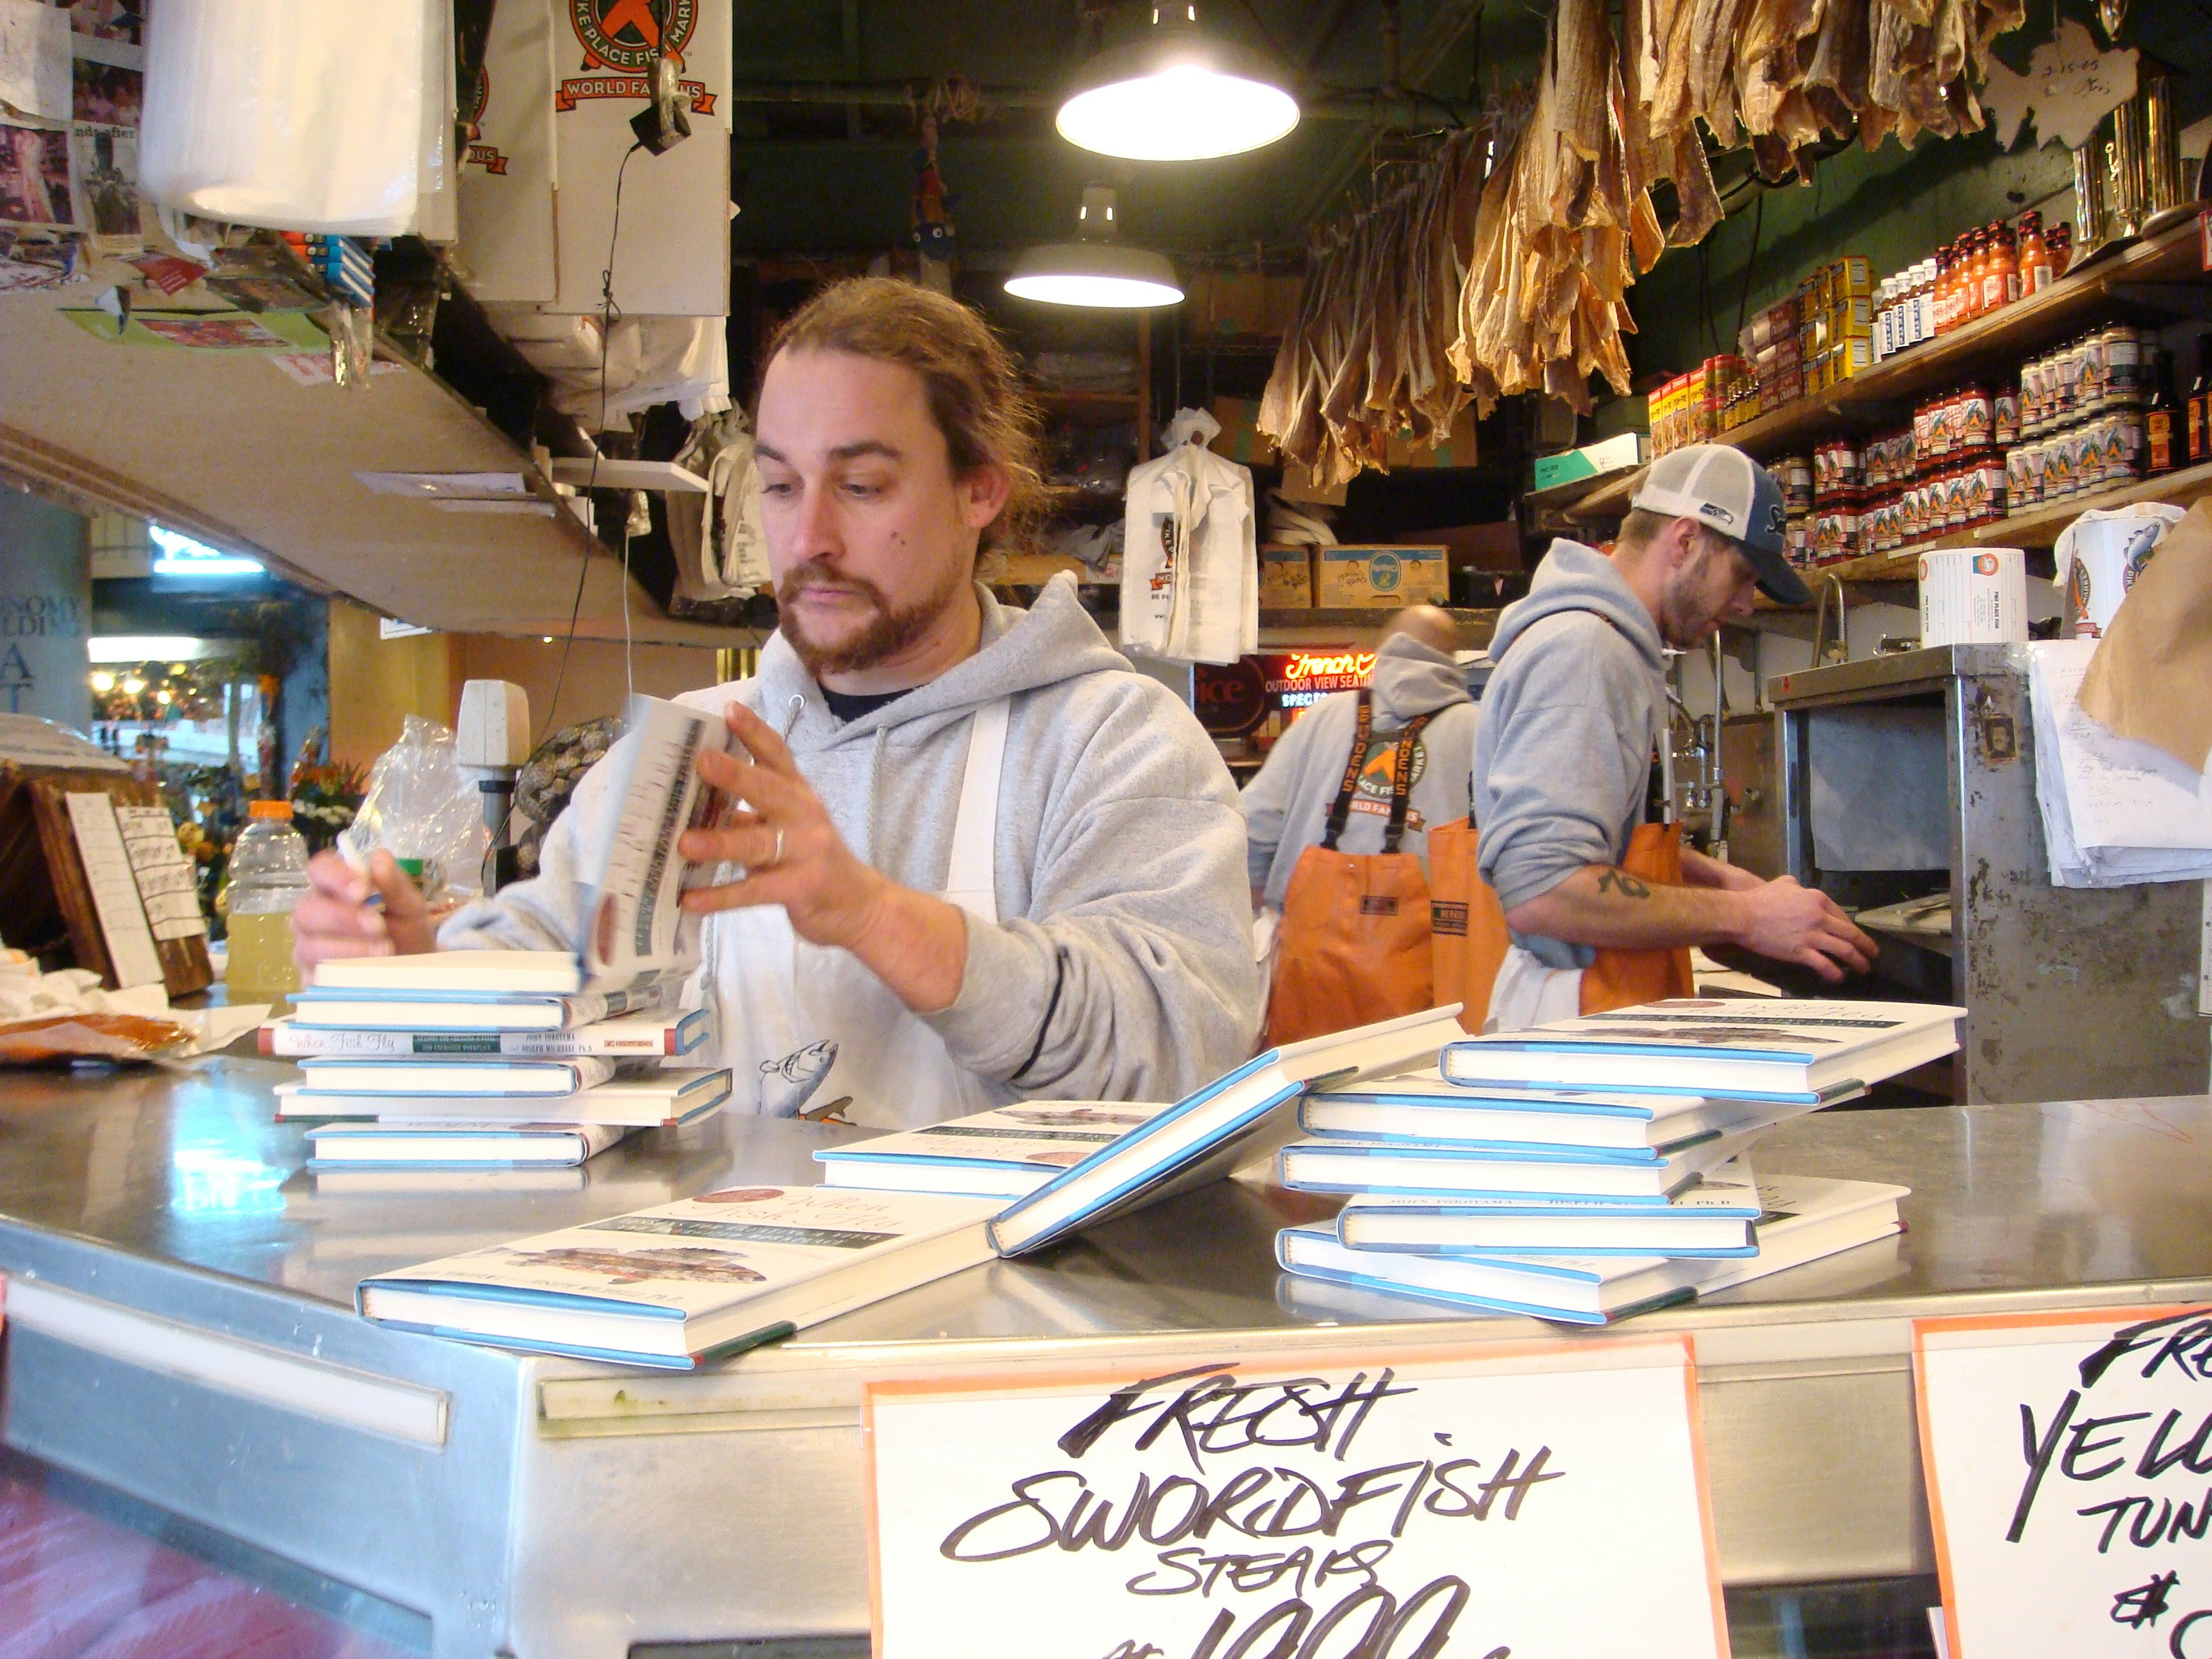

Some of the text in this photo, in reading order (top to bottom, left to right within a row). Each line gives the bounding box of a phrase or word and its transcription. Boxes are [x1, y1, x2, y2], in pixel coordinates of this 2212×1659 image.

[584, 28, 630, 65] PLACE
[567, 81, 701, 99] WORLD FAUS
[1265, 674, 1376, 693] OUTDOOR VIEW SEATIN
[1286, 653, 1355, 679] French
[290, 1032, 395, 1051] When Fish Fly
[668, 1194, 904, 1231] When Fish Fly
[1058, 1362, 1417, 1475] FRESH
[941, 1432, 1565, 1562] SWORDFISH
[1125, 1540, 1393, 1598] STEAKS
